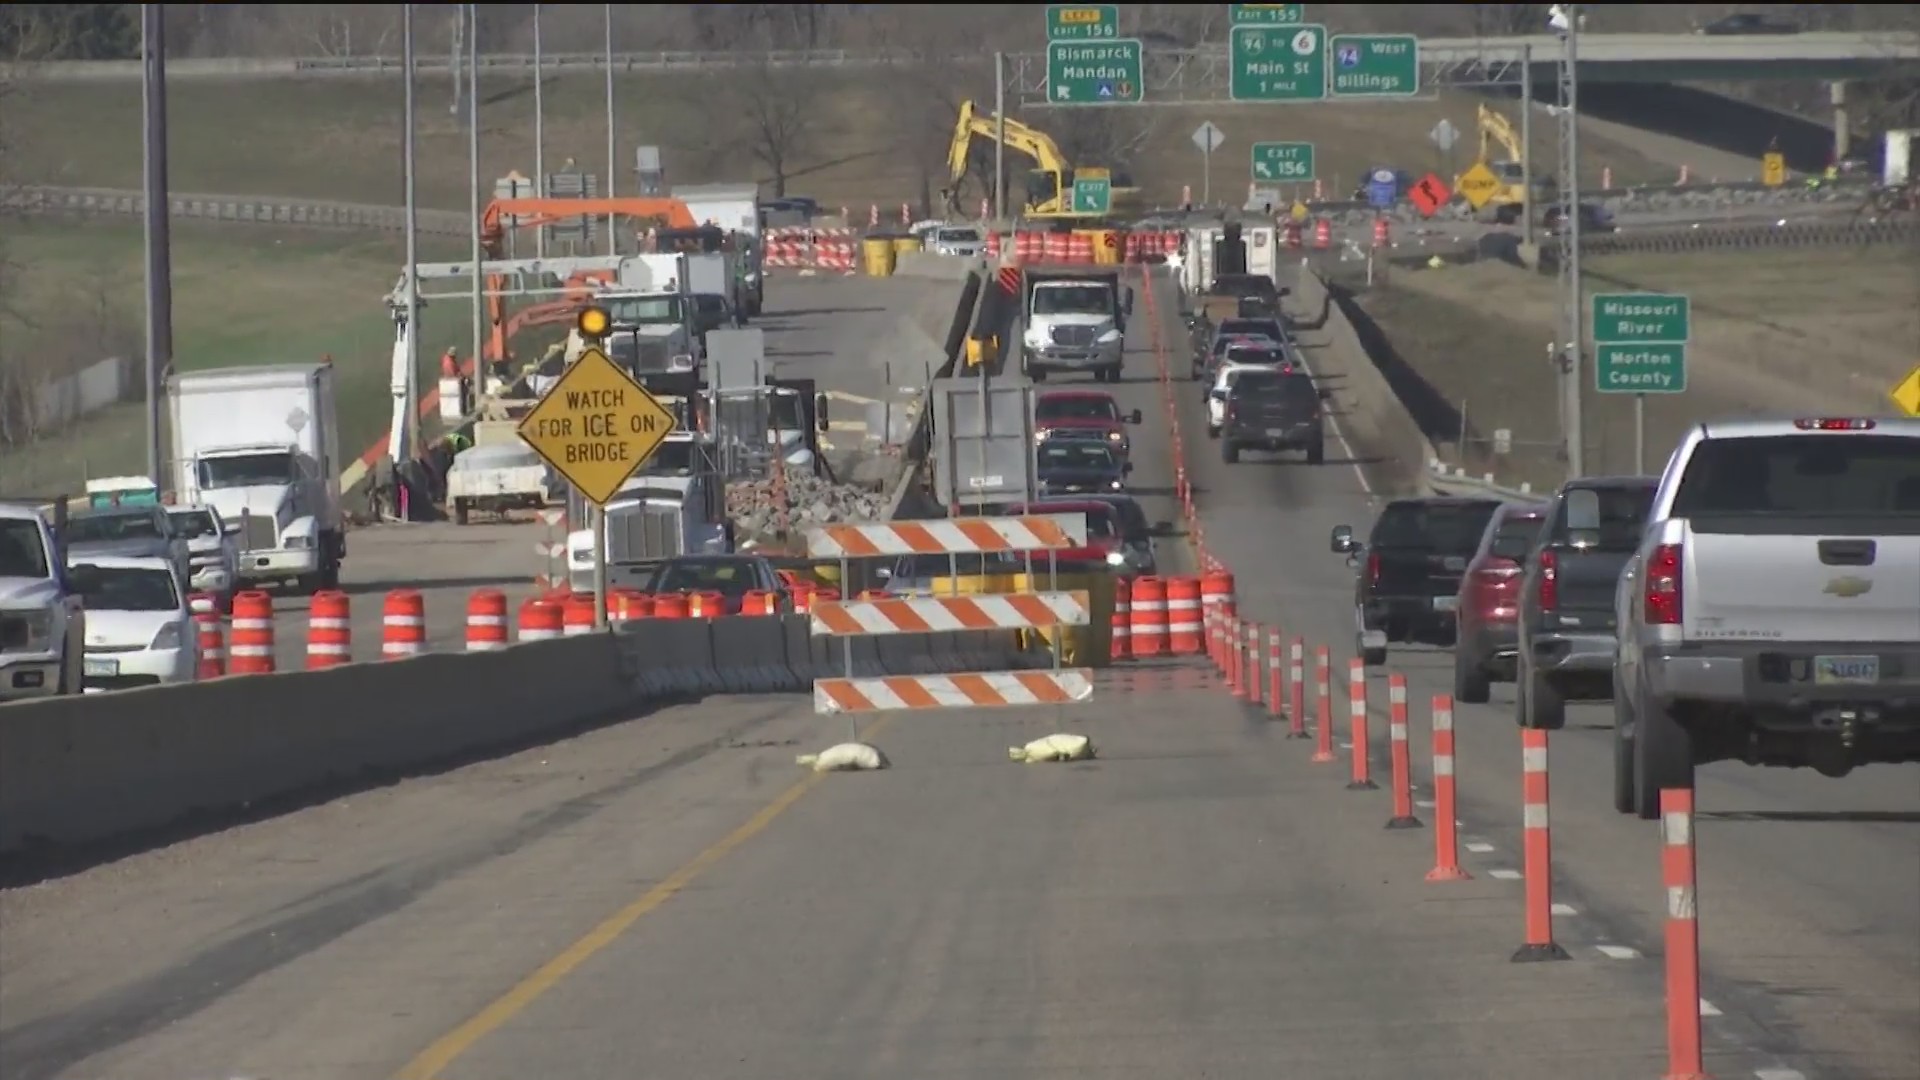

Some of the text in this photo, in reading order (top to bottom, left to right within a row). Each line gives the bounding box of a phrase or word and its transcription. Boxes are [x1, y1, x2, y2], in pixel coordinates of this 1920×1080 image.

[1237, 9, 1297, 21] EXIT 155
[1053, 24, 1113, 36] EXIT 156
[1244, 39, 1261, 50] 94
[1298, 35, 1310, 49] 6
[1057, 46, 1132, 60] Bismarck
[1063, 66, 1127, 79] Mandan
[1246, 60, 1310, 75] Main St
[1274, 82, 1297, 91] MILE
[1337, 73, 1399, 89] Billings
[1267, 148, 1298, 158] EXIT
[1278, 161, 1306, 175] 156
[1079, 182, 1105, 191] EXIT
[1604, 302, 1677, 316] Missouri
[1617, 321, 1665, 335] River
[1610, 351, 1671, 365] Morton
[1609, 371, 1672, 387] County
[566, 390, 624, 410] WATCH
[539, 413, 655, 438] FOR ICE ON
[566, 442, 629, 463] BRIDGE
